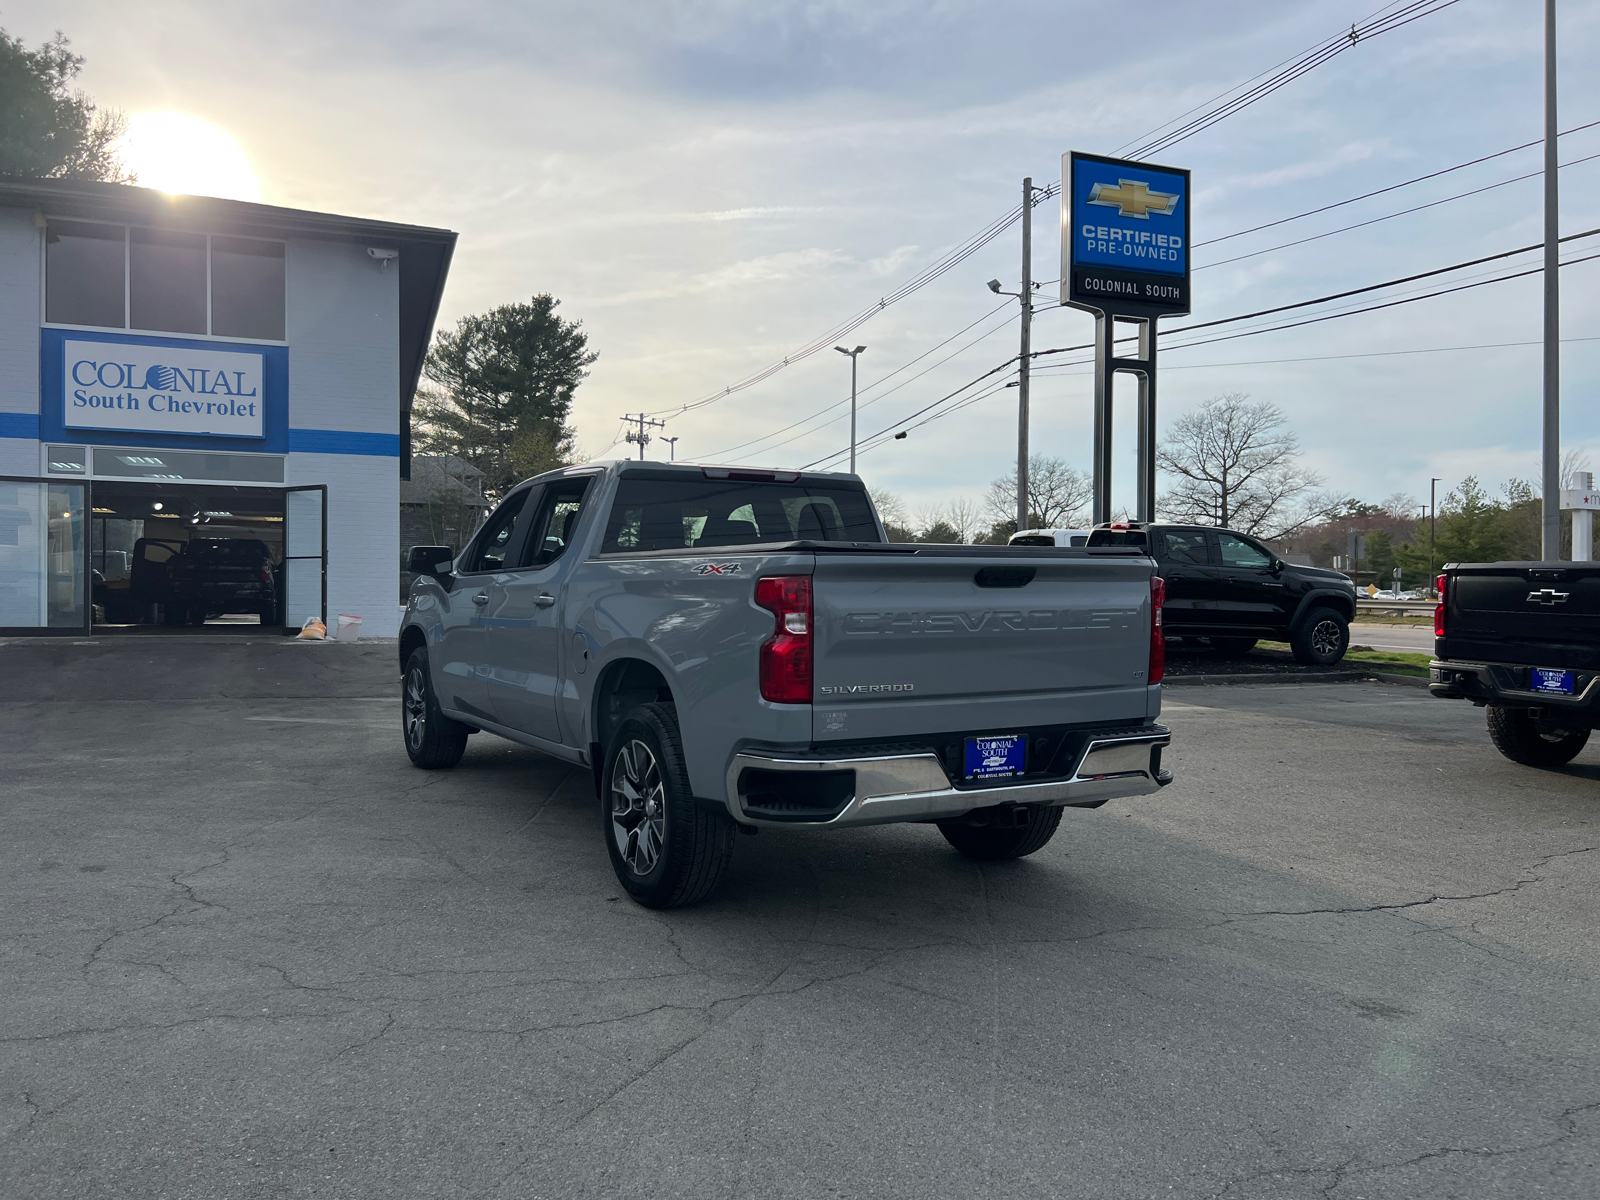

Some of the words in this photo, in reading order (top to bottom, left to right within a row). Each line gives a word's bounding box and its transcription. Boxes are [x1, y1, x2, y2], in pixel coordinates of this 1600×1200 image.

[1083, 225, 1181, 249] CERTIFIED
[1088, 240, 1177, 261] PRE-OWNED
[1085, 278, 1139, 294] COLONIAL
[1146, 284, 1179, 298] SOUTH
[72, 360, 257, 397] COLONIAL
[73, 389, 140, 411] South
[147, 394, 257, 417] Chevrolet
[845, 608, 1139, 635] CHEVROLET
[1132, 670, 1145, 678] LT
[821, 683, 914, 694] SILVERADO
[977, 741, 1013, 750] COLONIAL
[982, 748, 1007, 757] SOUTH
